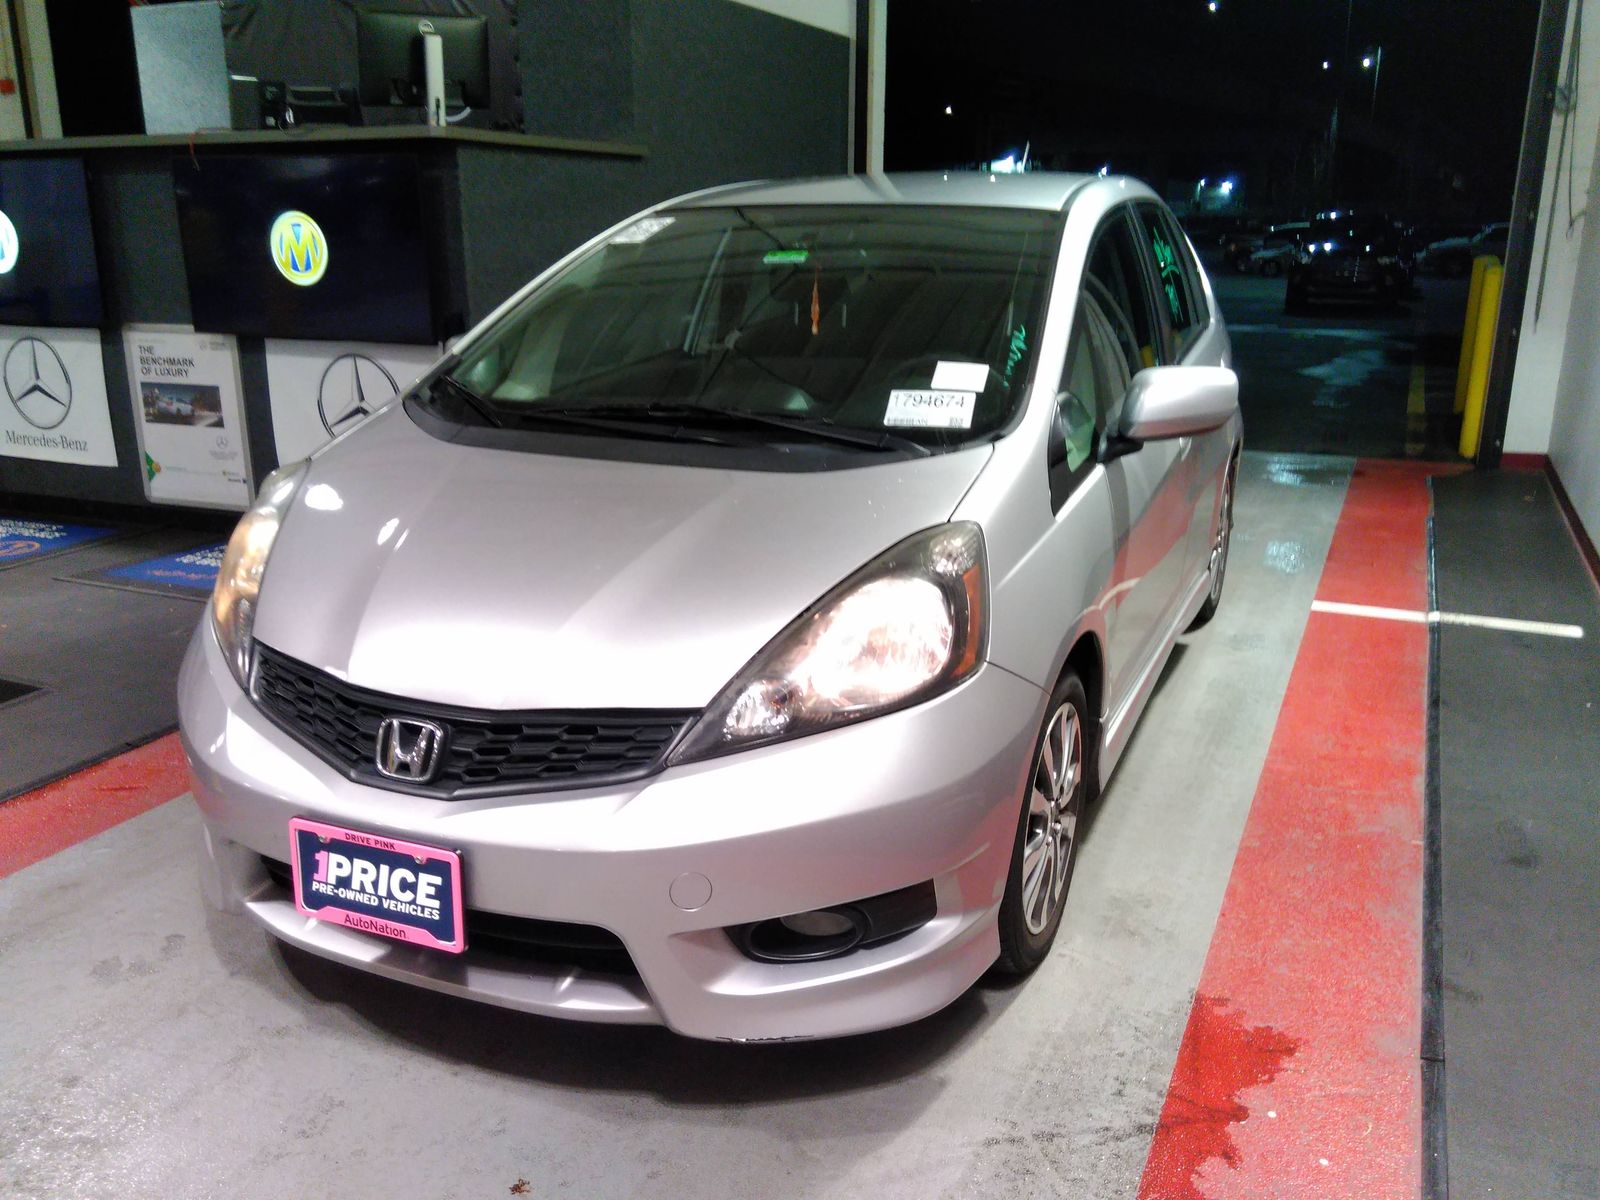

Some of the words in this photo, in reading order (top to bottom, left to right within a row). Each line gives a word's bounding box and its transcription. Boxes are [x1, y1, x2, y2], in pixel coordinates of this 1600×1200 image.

[138, 344, 154, 355] THE
[140, 356, 195, 368] BENCHMARK
[141, 366, 153, 376] OF
[155, 367, 190, 378] LUXURY
[893, 392, 965, 408] 1794674
[5, 429, 88, 452] Mercedes-Benz
[344, 832, 371, 846] DRIVE
[374, 839, 396, 851] PINK
[312, 850, 442, 910] 1PRICE
[311, 880, 379, 907] PRE-OWNED
[381, 897, 441, 921] VEHICLES
[343, 913, 407, 940] AutoNation
